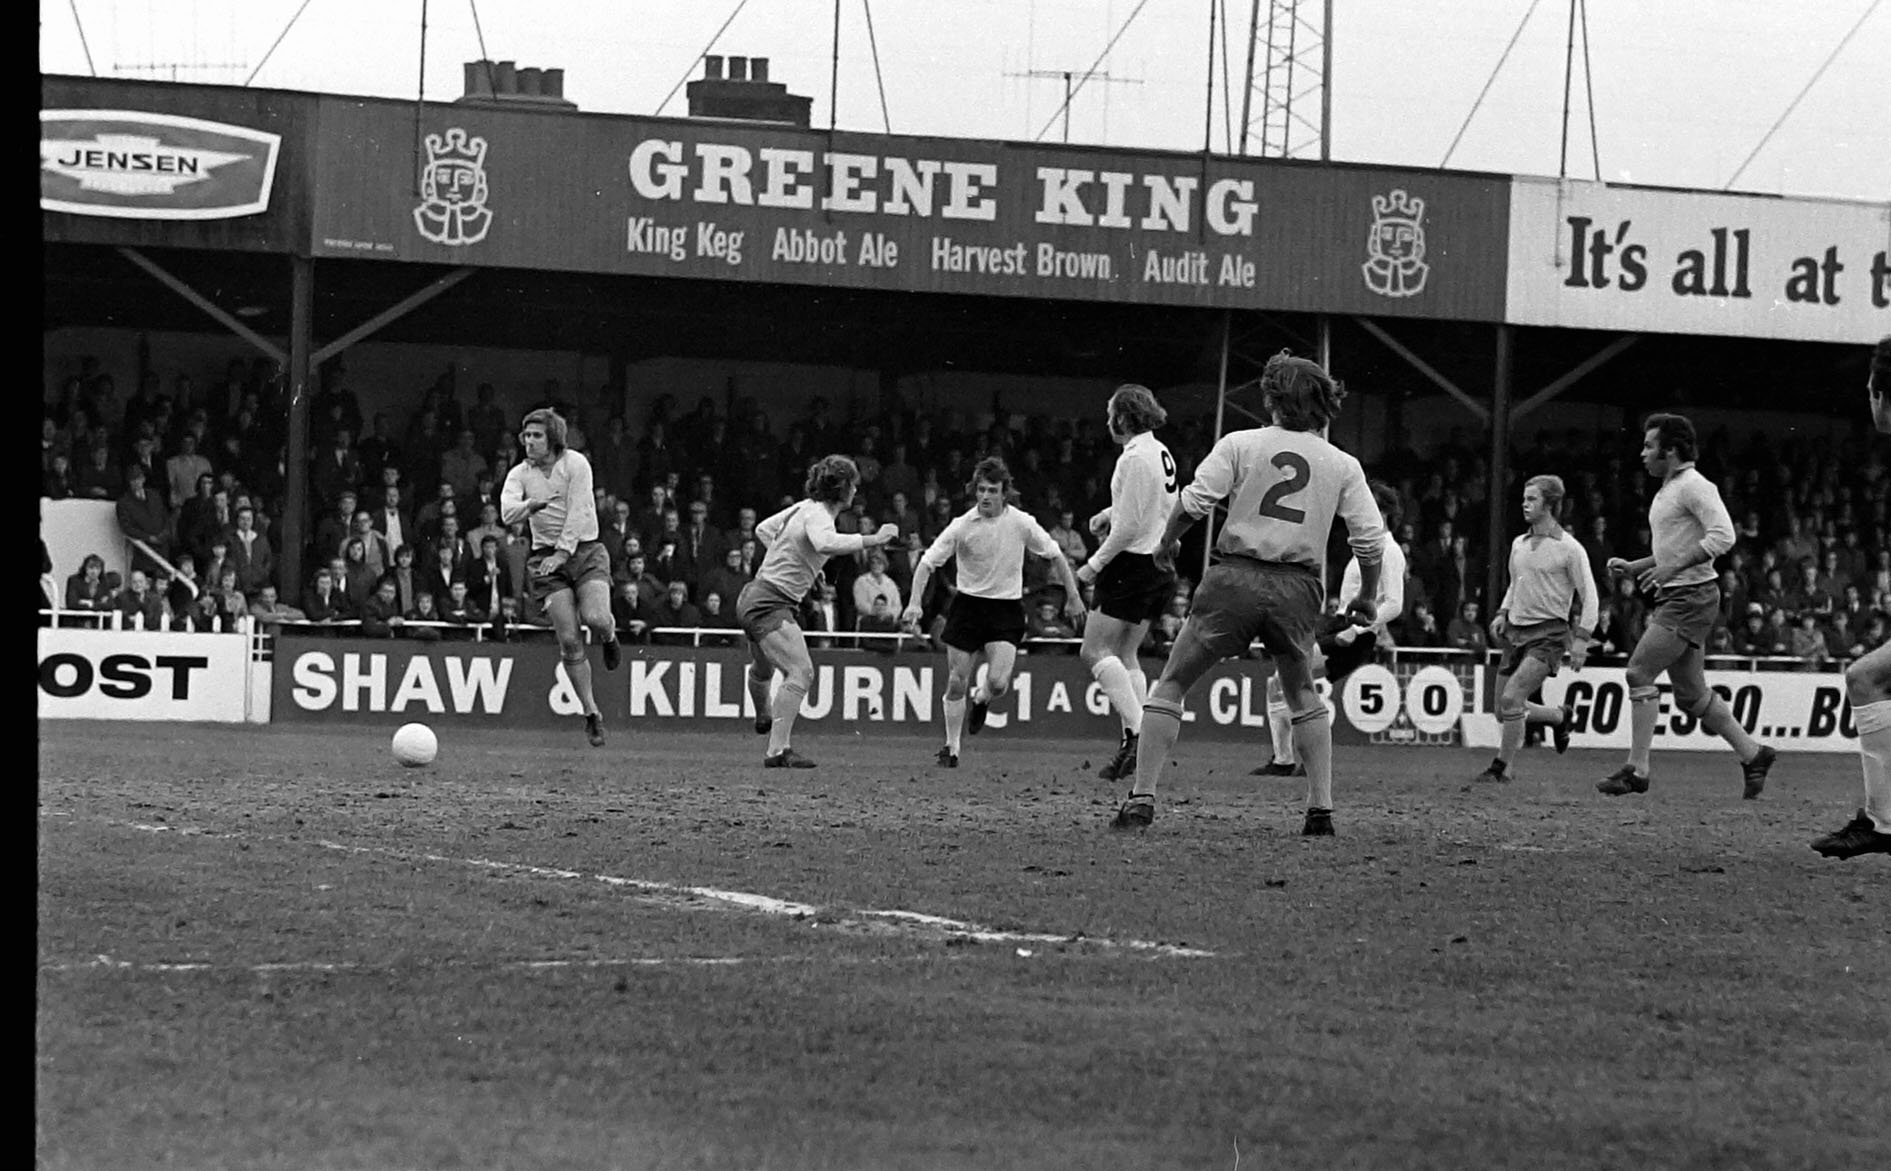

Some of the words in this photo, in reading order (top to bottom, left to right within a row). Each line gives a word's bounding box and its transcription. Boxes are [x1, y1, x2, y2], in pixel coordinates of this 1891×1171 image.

[58, 148, 199, 174] JENSEN
[629, 138, 998, 220] GREENE
[1035, 166, 1259, 236] KING
[627, 217, 687, 262] King
[697, 221, 744, 265] Keg
[772, 227, 847, 264] Abbot
[858, 232, 898, 267] Ale
[932, 237, 1027, 275] Harvest
[1037, 242, 1111, 280] Brown
[1143, 250, 1209, 284] Audit
[1218, 254, 1256, 288] Ale
[1564, 216, 1648, 291] It's
[1671, 226, 1752, 299] all
[1785, 245, 1844, 306] at
[1161, 450, 1177, 494] 9
[1259, 451, 1306, 525] 2
[37, 652, 208, 700] OST
[292, 651, 513, 715] SHAW
[548, 660, 585, 716] &
[1047, 681, 1073, 713] A
[1565, 681, 1624, 734] GO
